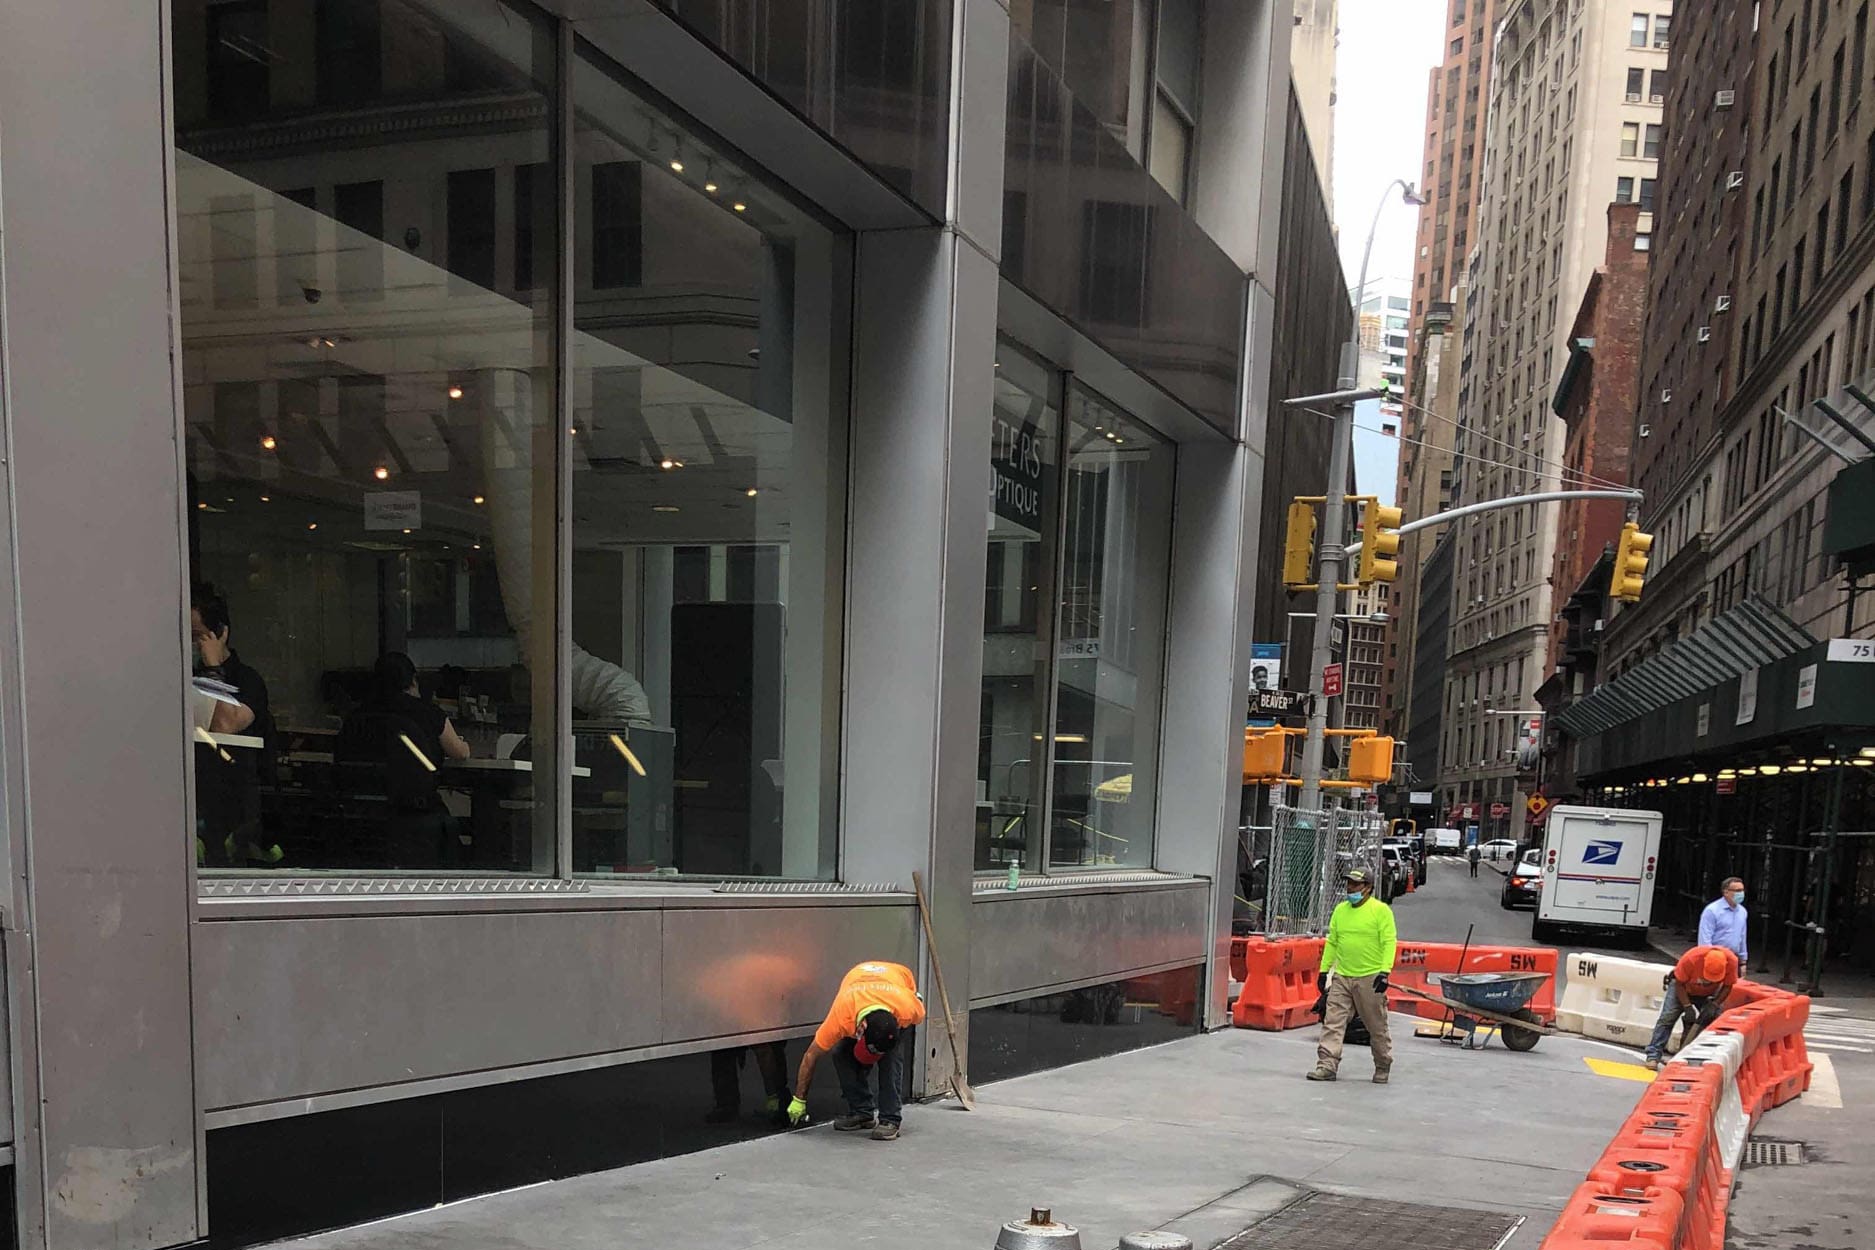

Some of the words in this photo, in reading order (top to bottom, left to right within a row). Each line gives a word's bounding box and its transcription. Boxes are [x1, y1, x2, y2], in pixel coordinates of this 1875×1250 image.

[991, 416, 1040, 479] TERS
[1853, 645, 1870, 657] 75
[1260, 694, 1288, 710] BEAVER
[1510, 954, 1536, 971] SW
[1578, 960, 1598, 979] SW
